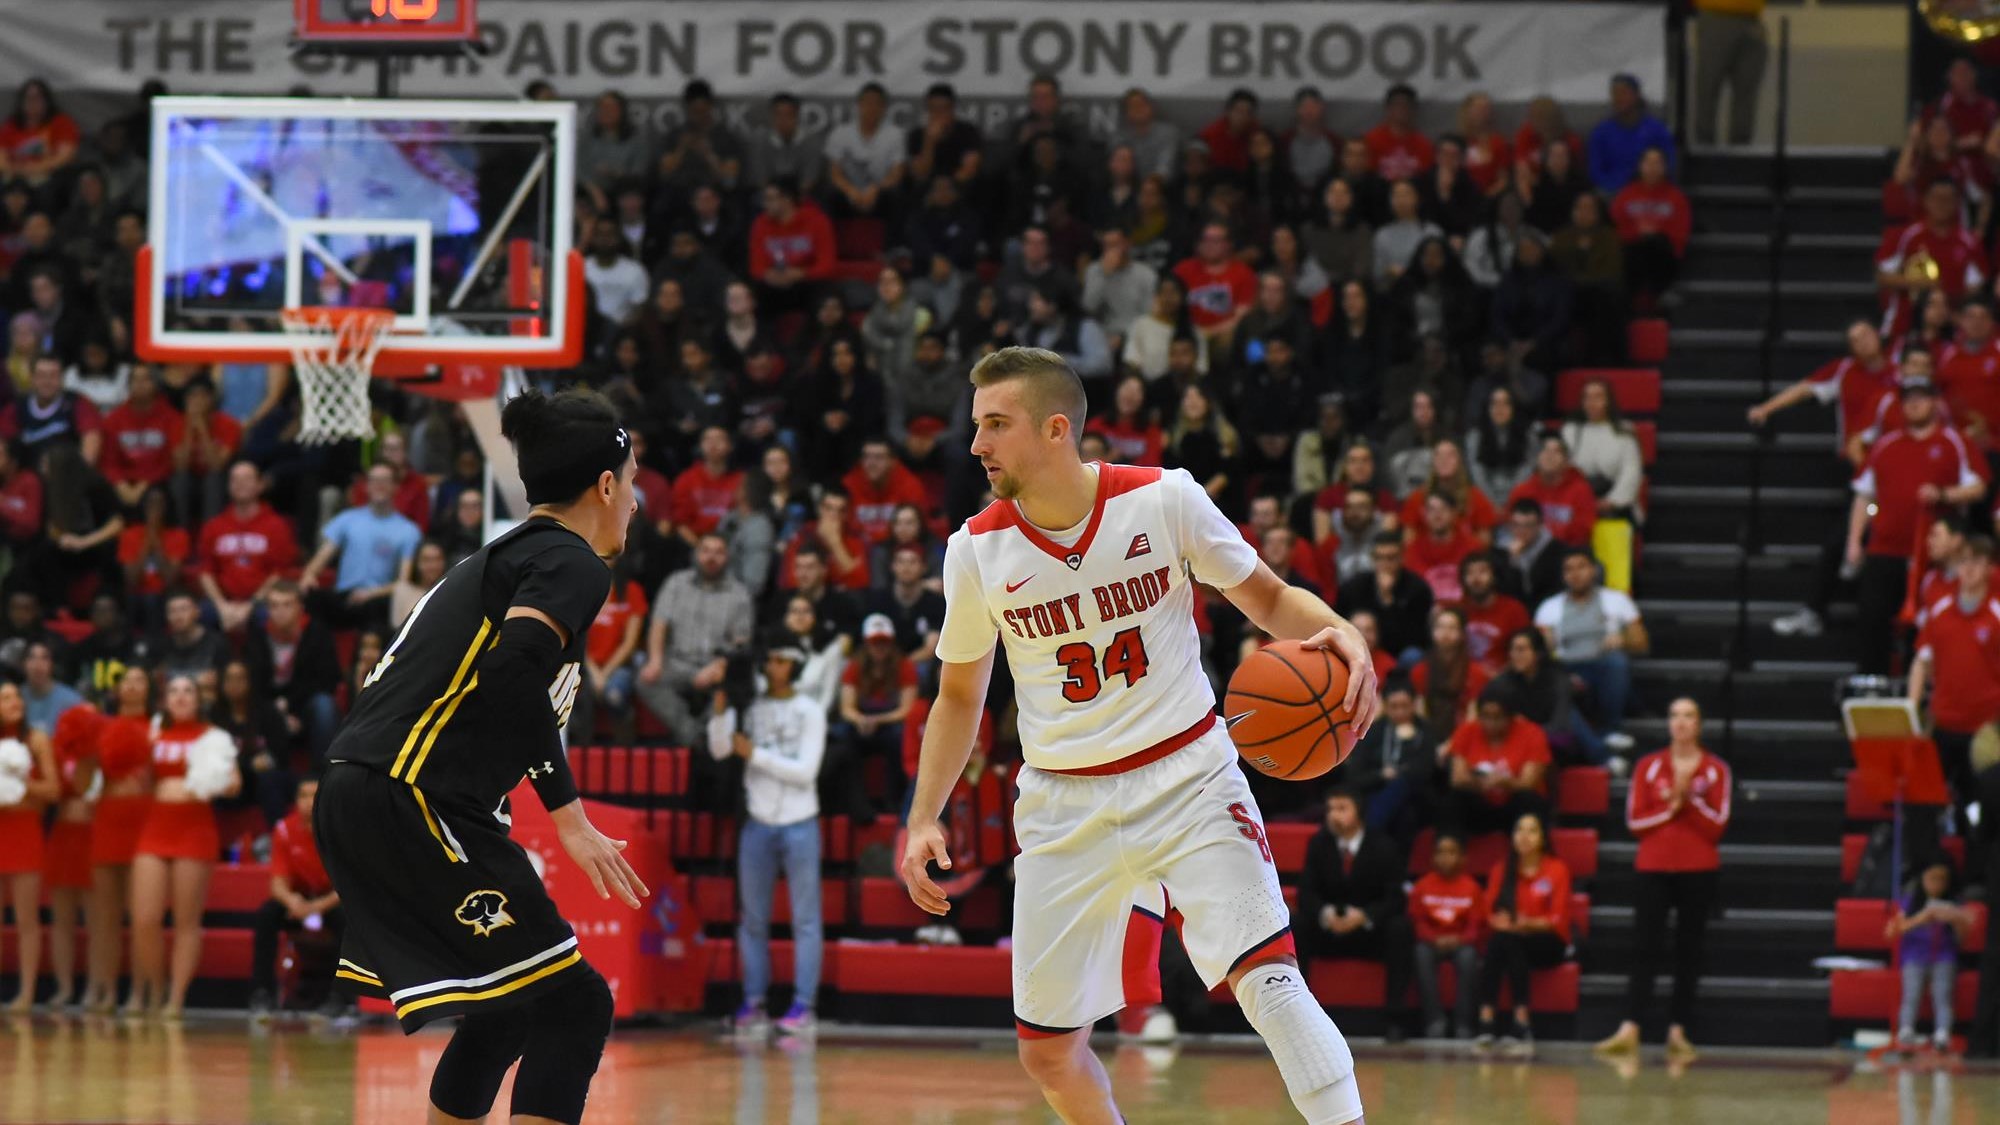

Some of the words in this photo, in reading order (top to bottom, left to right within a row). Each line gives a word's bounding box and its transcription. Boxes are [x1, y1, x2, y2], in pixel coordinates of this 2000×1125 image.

[105, 18, 254, 73] THE
[287, 19, 697, 77] PAIGN
[737, 19, 885, 77] FOR
[922, 17, 1187, 76] STONY
[1208, 21, 1482, 80] BROOK
[1003, 593, 1085, 639] STONY
[1092, 566, 1170, 622] BROOK
[1056, 625, 1149, 703] 34
